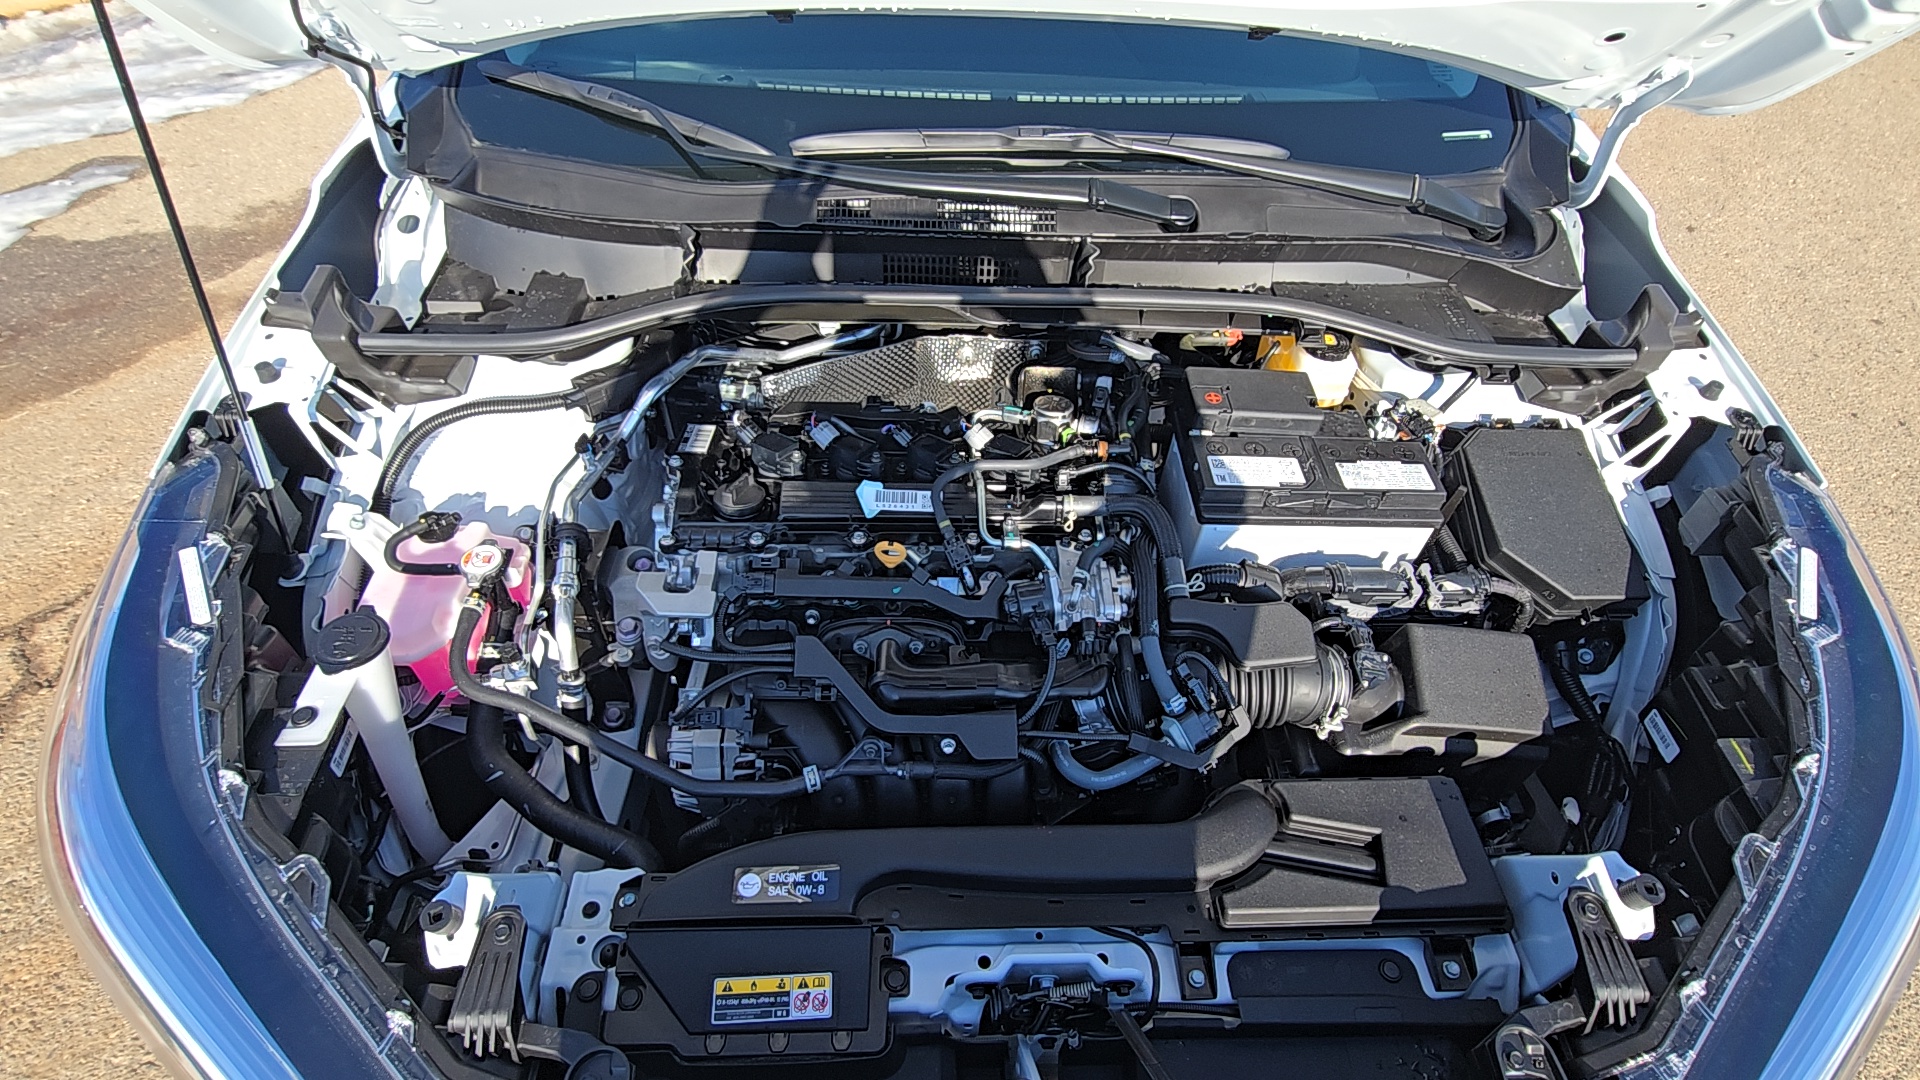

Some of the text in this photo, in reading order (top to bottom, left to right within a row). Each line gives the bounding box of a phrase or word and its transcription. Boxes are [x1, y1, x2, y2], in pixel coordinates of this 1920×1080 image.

[1215, 474, 1227, 483] TM
[768, 871, 828, 883] ENGINE OIL
[768, 884, 825, 896] SAE 0W-8
